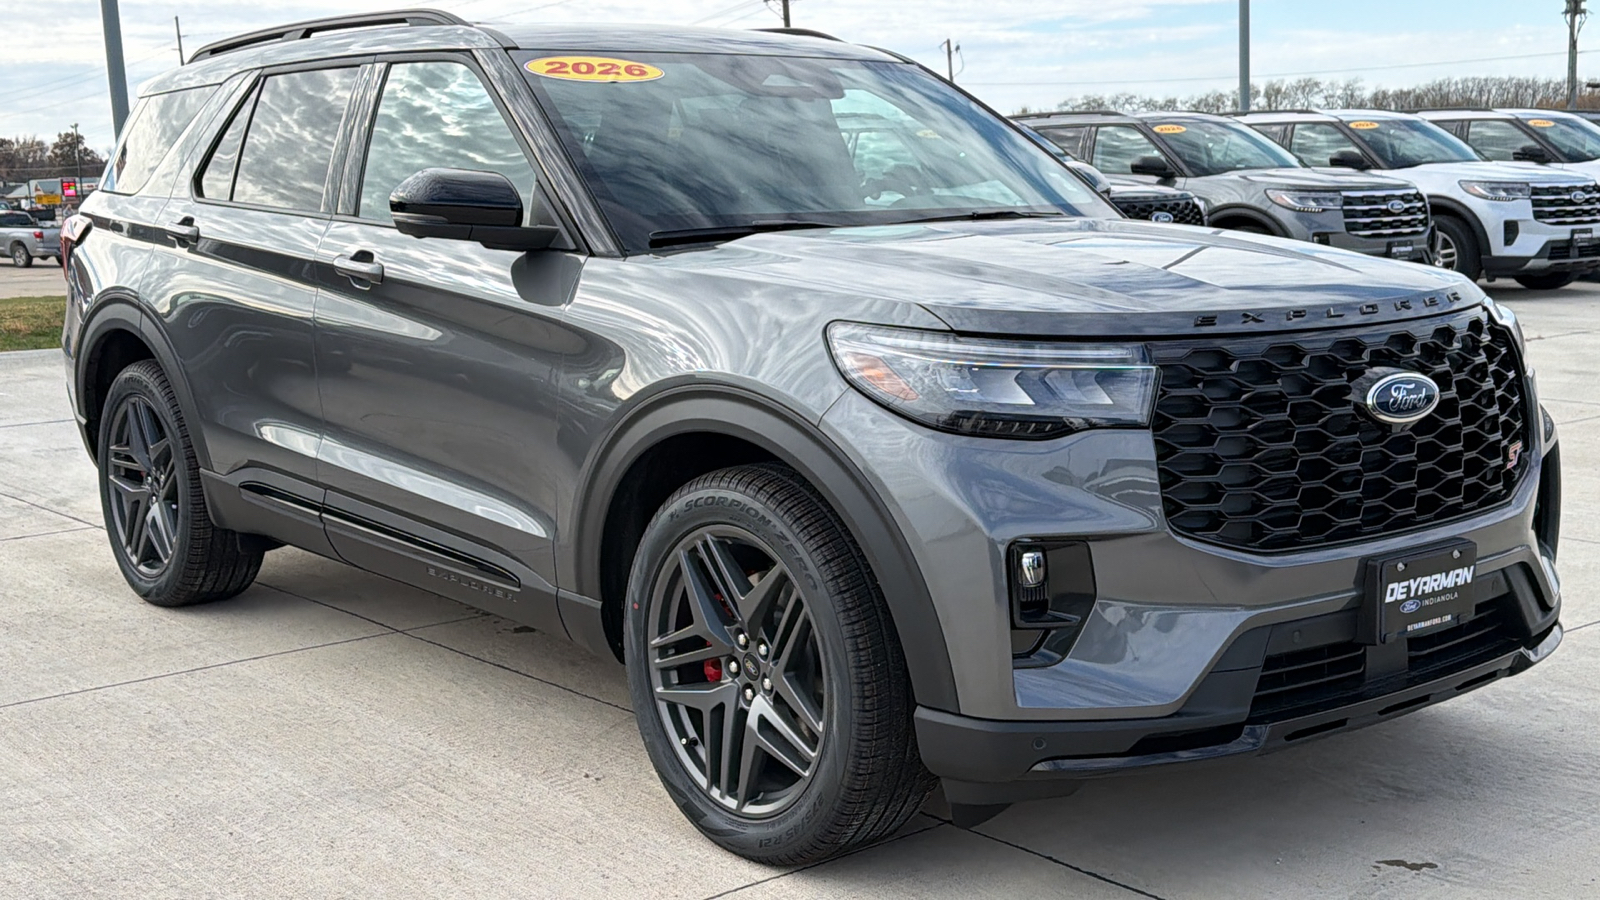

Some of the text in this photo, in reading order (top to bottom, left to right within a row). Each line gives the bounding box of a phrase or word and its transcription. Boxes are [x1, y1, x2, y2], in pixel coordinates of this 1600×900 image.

[545, 61, 648, 77] 2026
[1194, 291, 1462, 327] EXPLORER
[1388, 383, 1427, 412] Ford
[683, 495, 772, 528] SCORPION
[774, 530, 818, 591] ZERO
[1384, 565, 1475, 604] DEYARMAN
[1421, 591, 1459, 607] INDIANOLA
